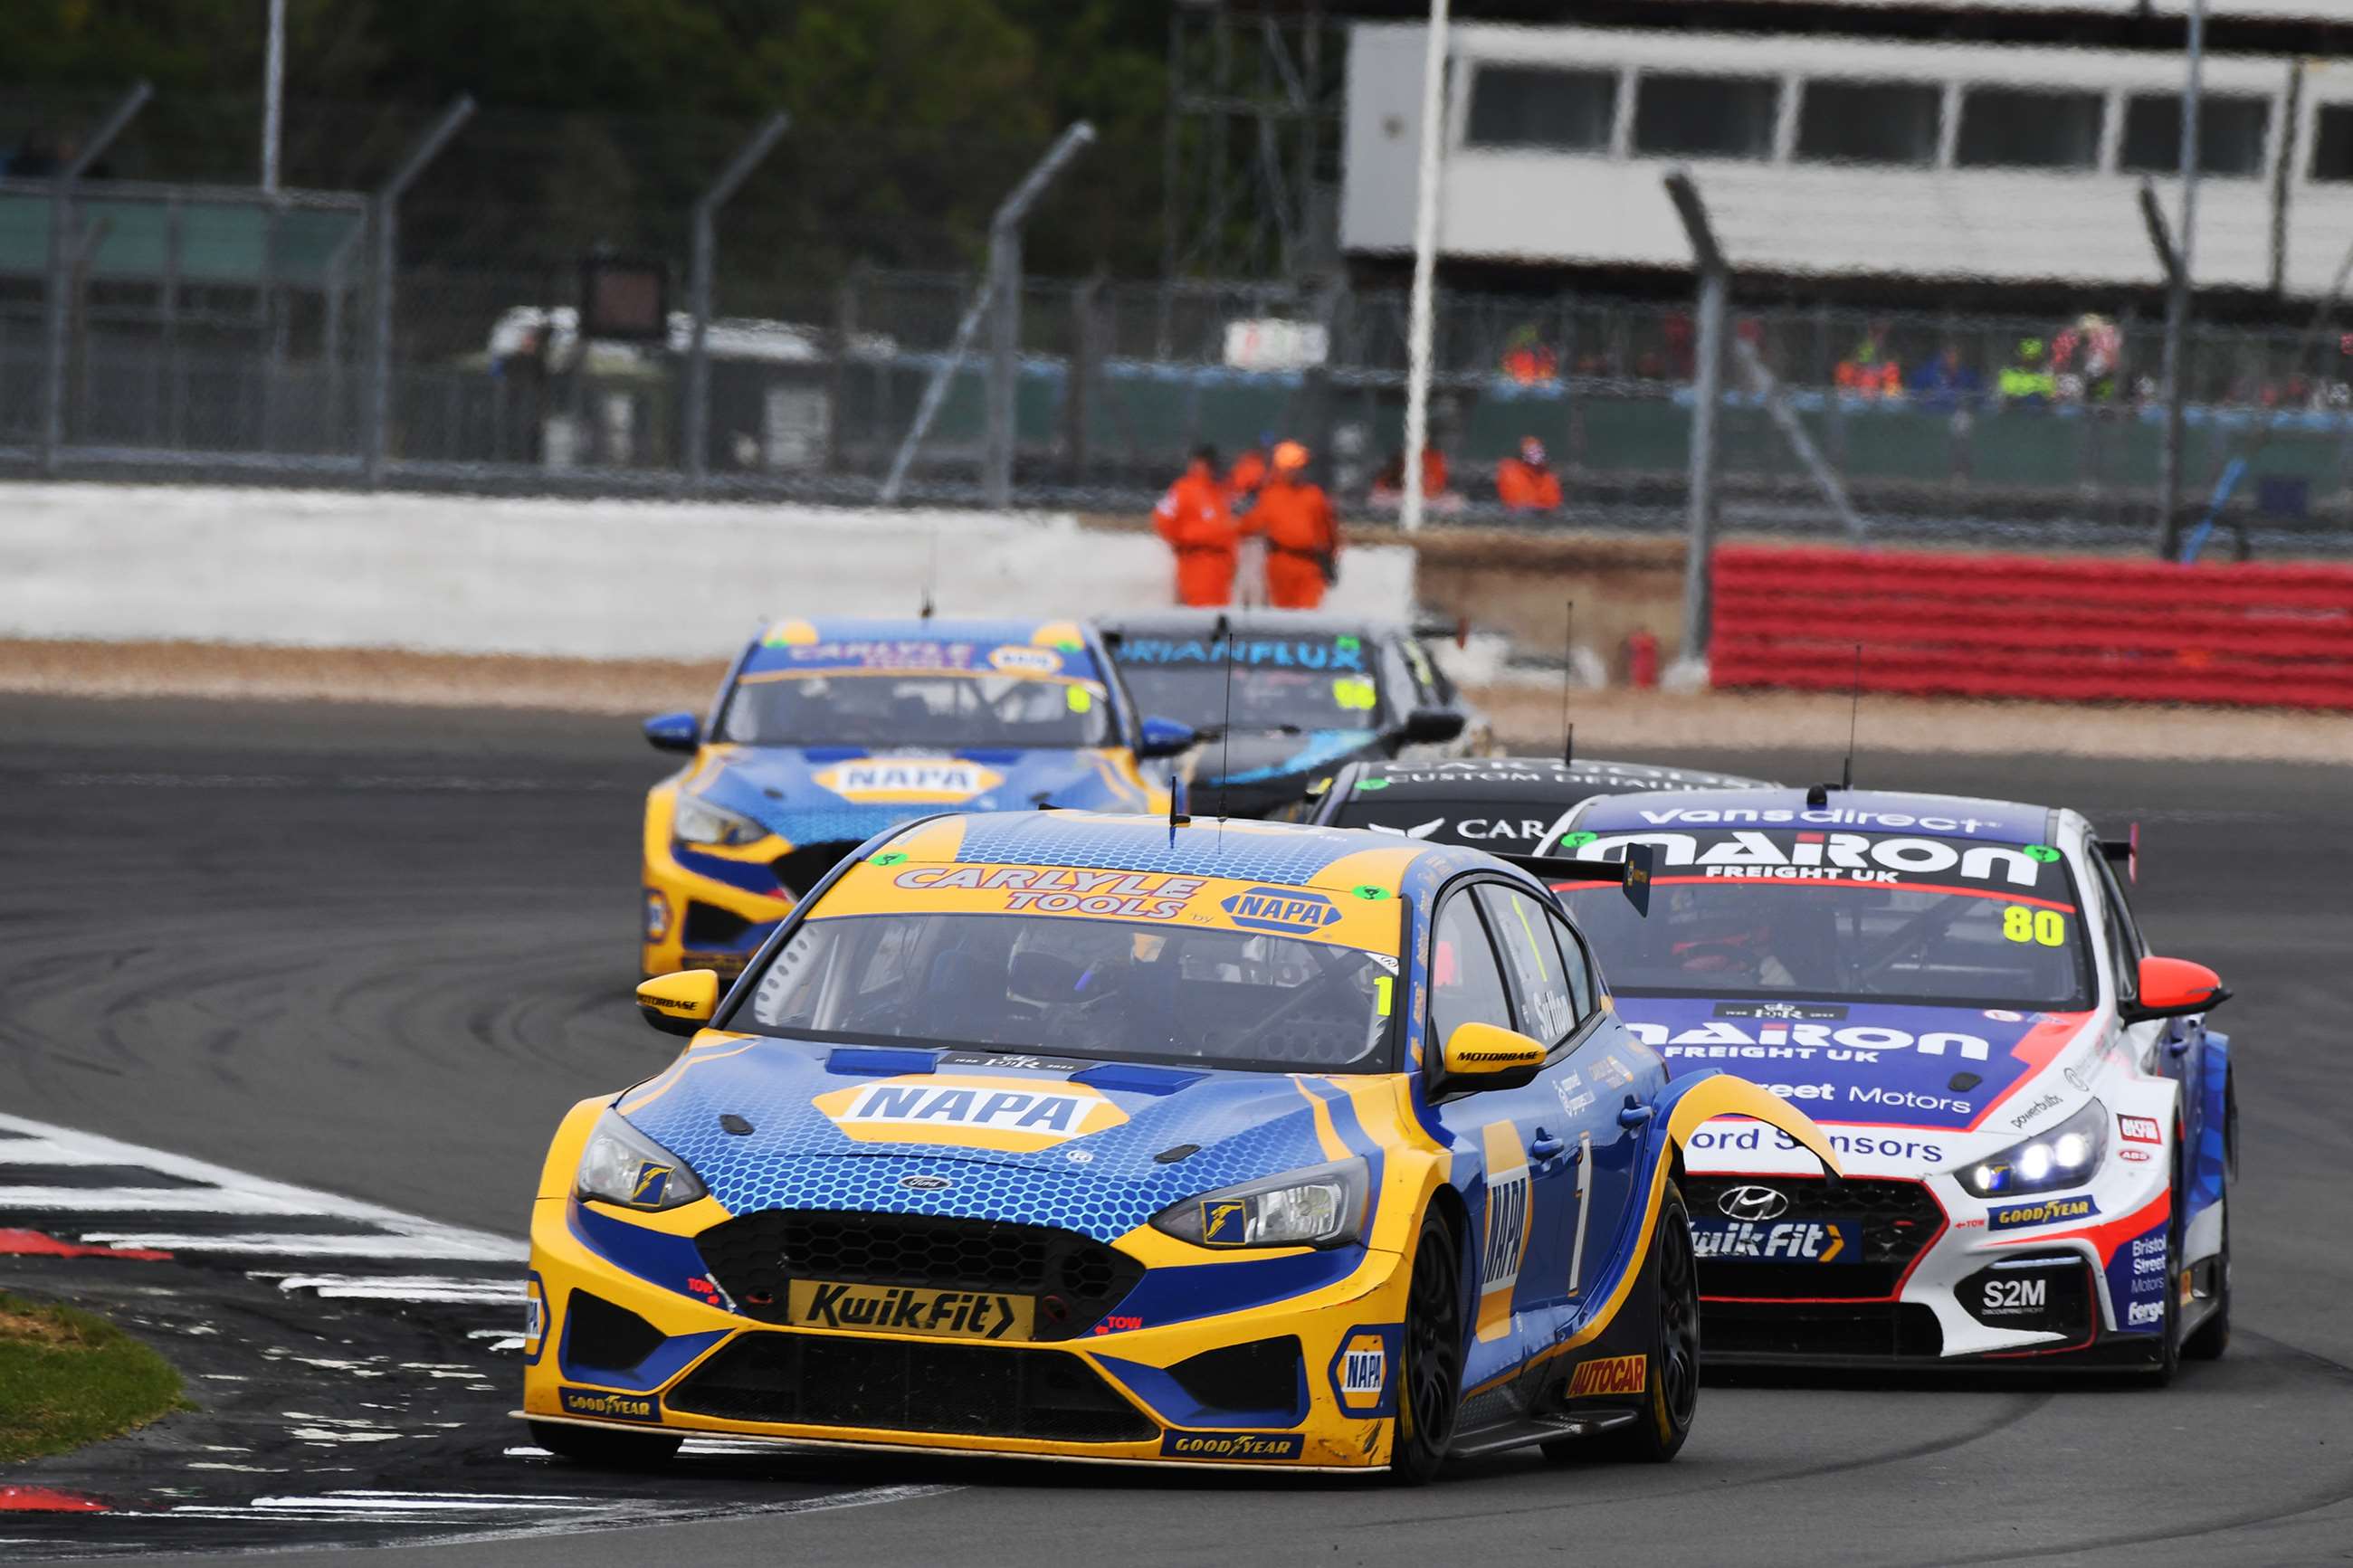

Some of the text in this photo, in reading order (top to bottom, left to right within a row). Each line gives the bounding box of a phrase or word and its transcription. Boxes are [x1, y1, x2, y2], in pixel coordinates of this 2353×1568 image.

[847, 771, 968, 788] NAPA
[894, 868, 1205, 898] CARLYLE
[1706, 866, 1899, 883] FREIGHT UK
[1005, 891, 1187, 919] TOOLS
[1238, 896, 1322, 926] NAPA
[2003, 906, 2064, 946] 80
[1374, 975, 1393, 1016] 1
[1456, 1050, 1539, 1062] MOTORBASE
[1664, 1046, 1879, 1063] FREIGHT UK
[857, 1087, 1077, 1131] NAPA
[1849, 1086, 1971, 1114] Motors
[2010, 1094, 2064, 1129] powerbulbs
[1774, 1129, 1943, 1163] Snsors
[1998, 1200, 2090, 1223] GOODYEAR
[1483, 1177, 1528, 1286] NAPA
[1689, 1221, 1824, 1257] wikFit
[2132, 1234, 2167, 1258] Bristol
[2132, 1254, 2167, 1276] Street
[688, 1278, 714, 1294] TOW
[1983, 1279, 2046, 1308] S2M
[2130, 1277, 2165, 1294] Motors
[1107, 1316, 1144, 1329] TOW
[1347, 1355, 1382, 1388] NAPA
[1568, 1356, 1645, 1396] AUTOCAR
[567, 1394, 651, 1415] GOODYEAR
[1175, 1435, 1292, 1457] GOODYEAR
